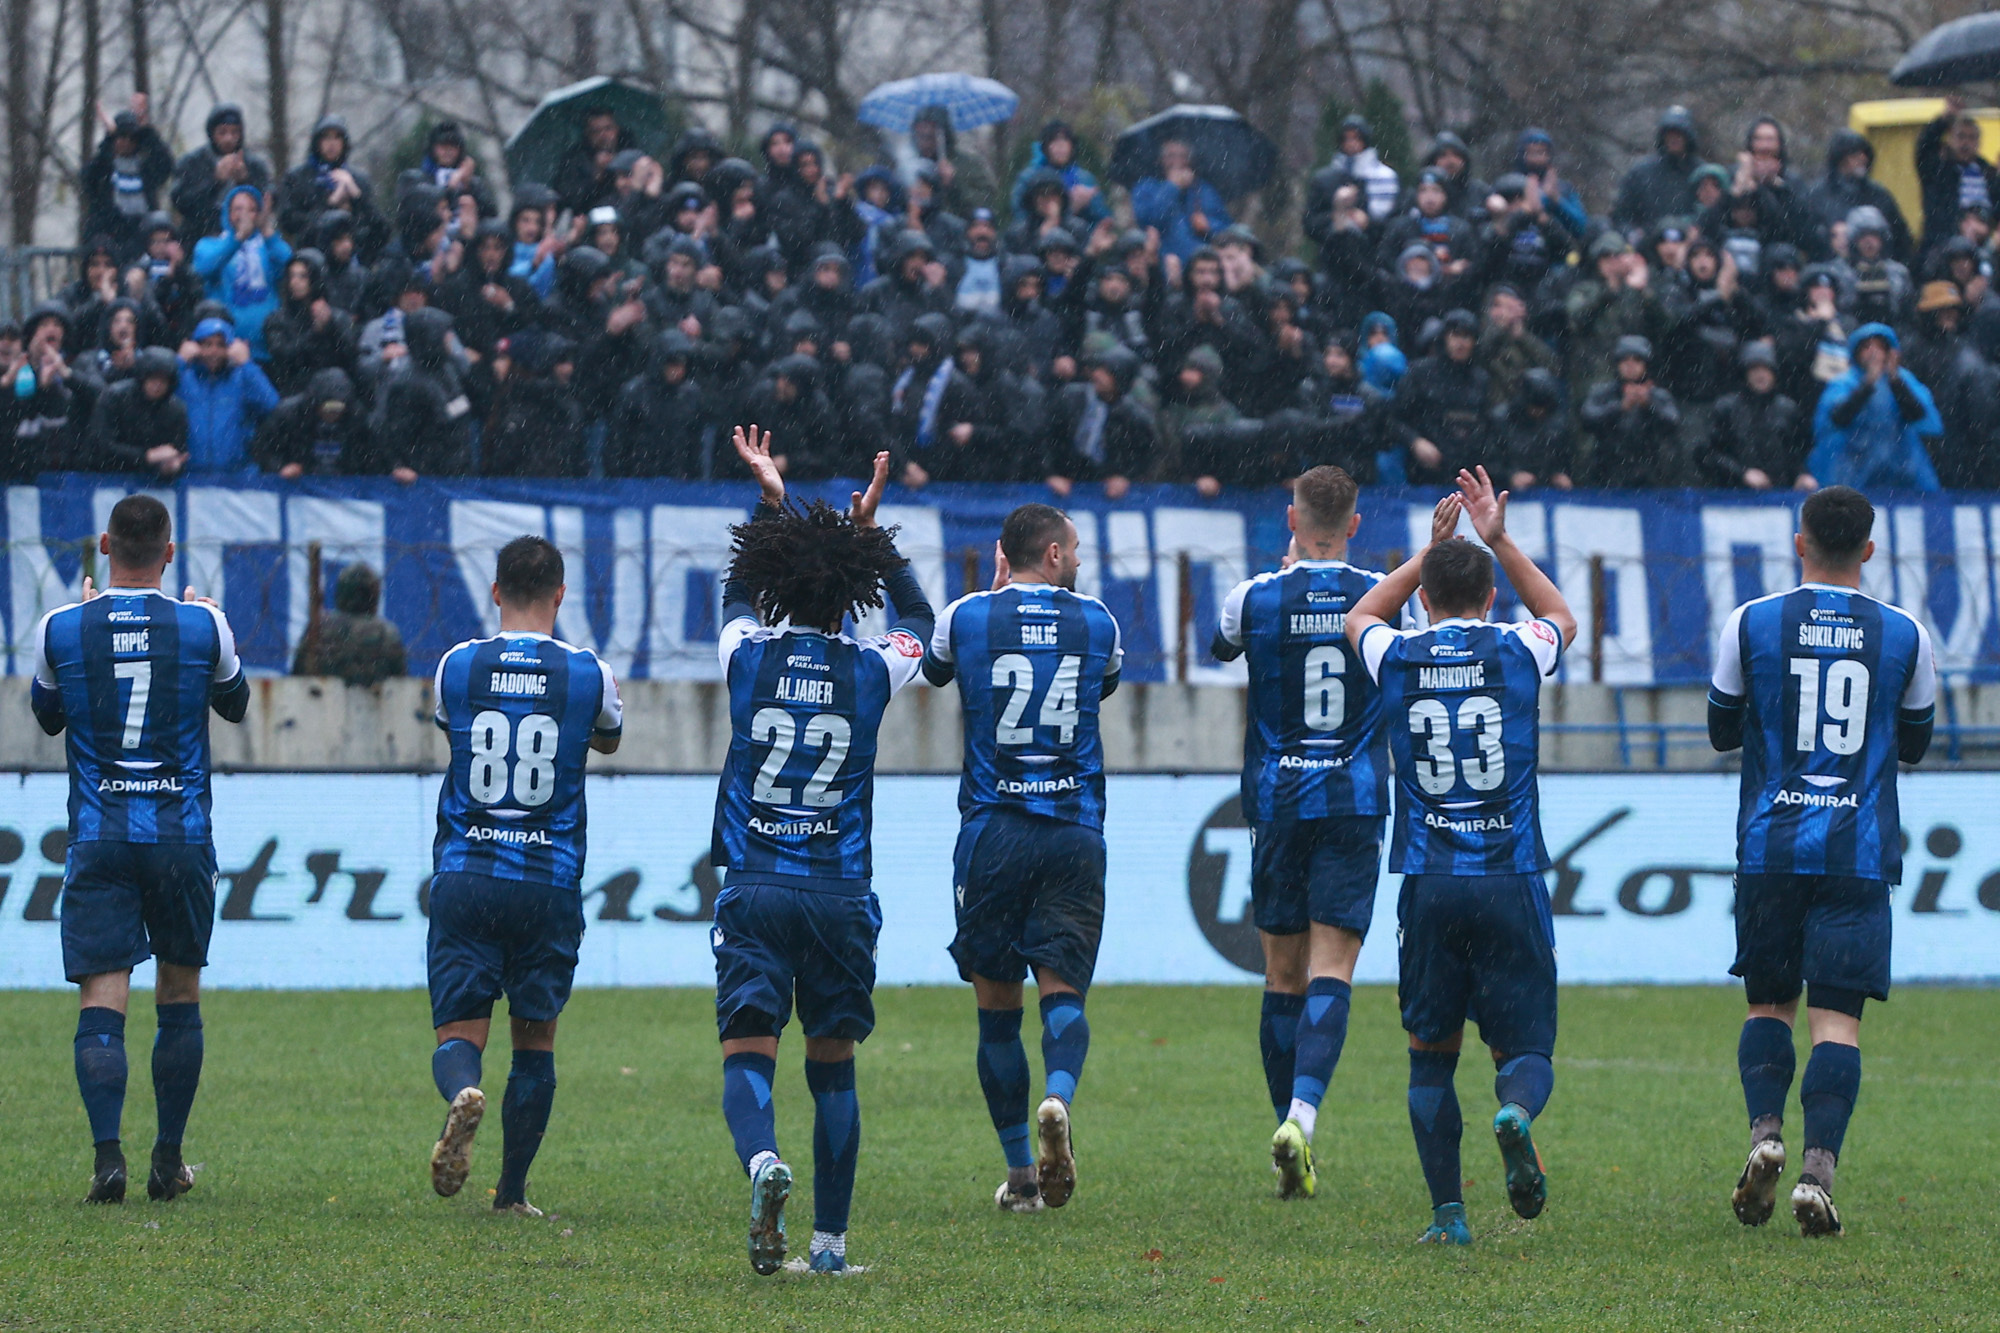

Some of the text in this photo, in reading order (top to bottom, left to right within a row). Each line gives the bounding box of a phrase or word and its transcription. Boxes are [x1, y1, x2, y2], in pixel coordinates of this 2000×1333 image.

[1818, 615, 1853, 624] SARAJEVO
[113, 629, 149, 652] KRPIĆ
[1021, 622, 1058, 645] GALIĆ
[1799, 622, 1864, 650] ŠUKILOVIĆ
[794, 660, 830, 671] SARAJEVO
[1419, 661, 1485, 689] MARKOVIĆ
[490, 672, 547, 695] RADOVAC
[775, 677, 834, 704] ALJABER
[1304, 645, 1346, 731] 6
[114, 661, 151, 749] 7
[991, 653, 1081, 744] 24
[1789, 657, 1870, 756] 19
[1408, 695, 1505, 795] 33
[469, 711, 559, 806] 88
[751, 708, 852, 808] 22
[98, 777, 183, 792] ADMIRAL
[996, 776, 1081, 793] ADMIRAL
[1773, 789, 1859, 808] ADMIRAL
[748, 817, 839, 835] ADMIRAL
[1424, 813, 1513, 832] ADMIRAL
[465, 825, 552, 845] ADMIRAL
